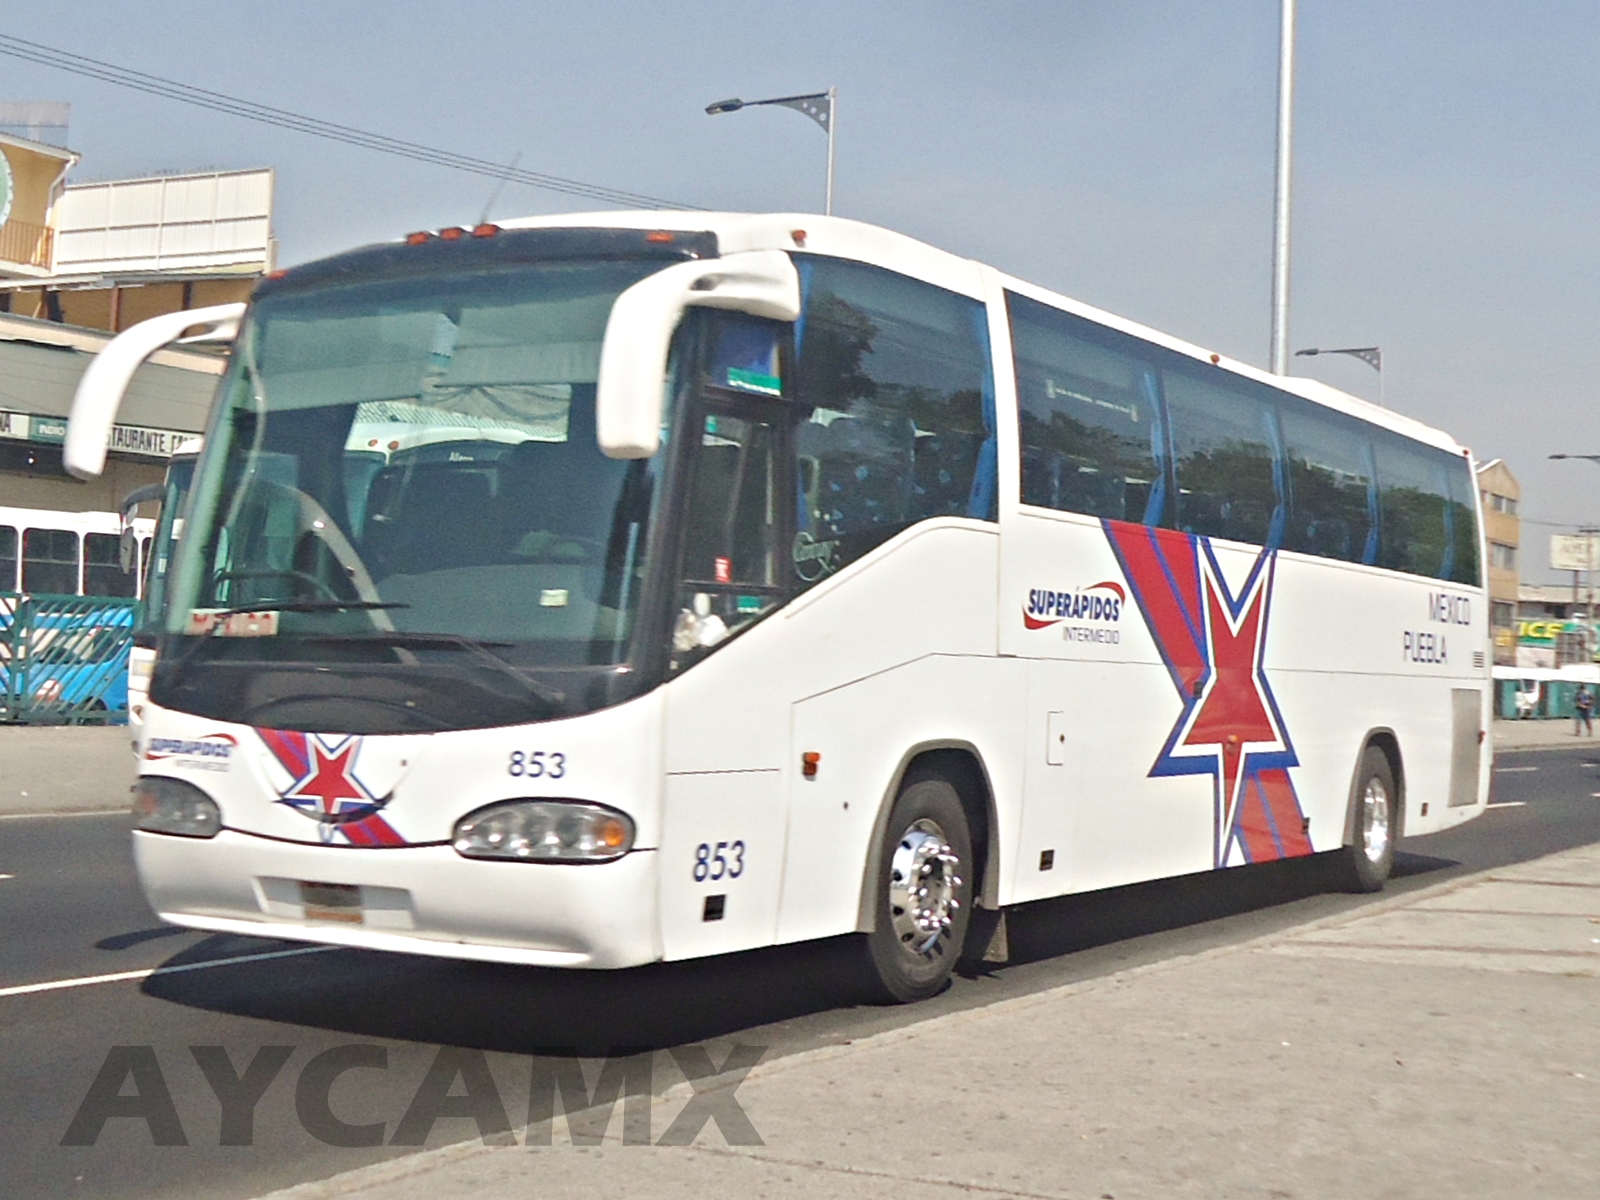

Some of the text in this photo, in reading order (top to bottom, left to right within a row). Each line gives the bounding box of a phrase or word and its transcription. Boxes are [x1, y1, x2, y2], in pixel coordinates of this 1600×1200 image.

[1028, 586, 1120, 622] SUPERÁPIDOS
[1404, 630, 1448, 664] PUEBLA
[508, 750, 567, 778] 853
[692, 840, 746, 883] 853
